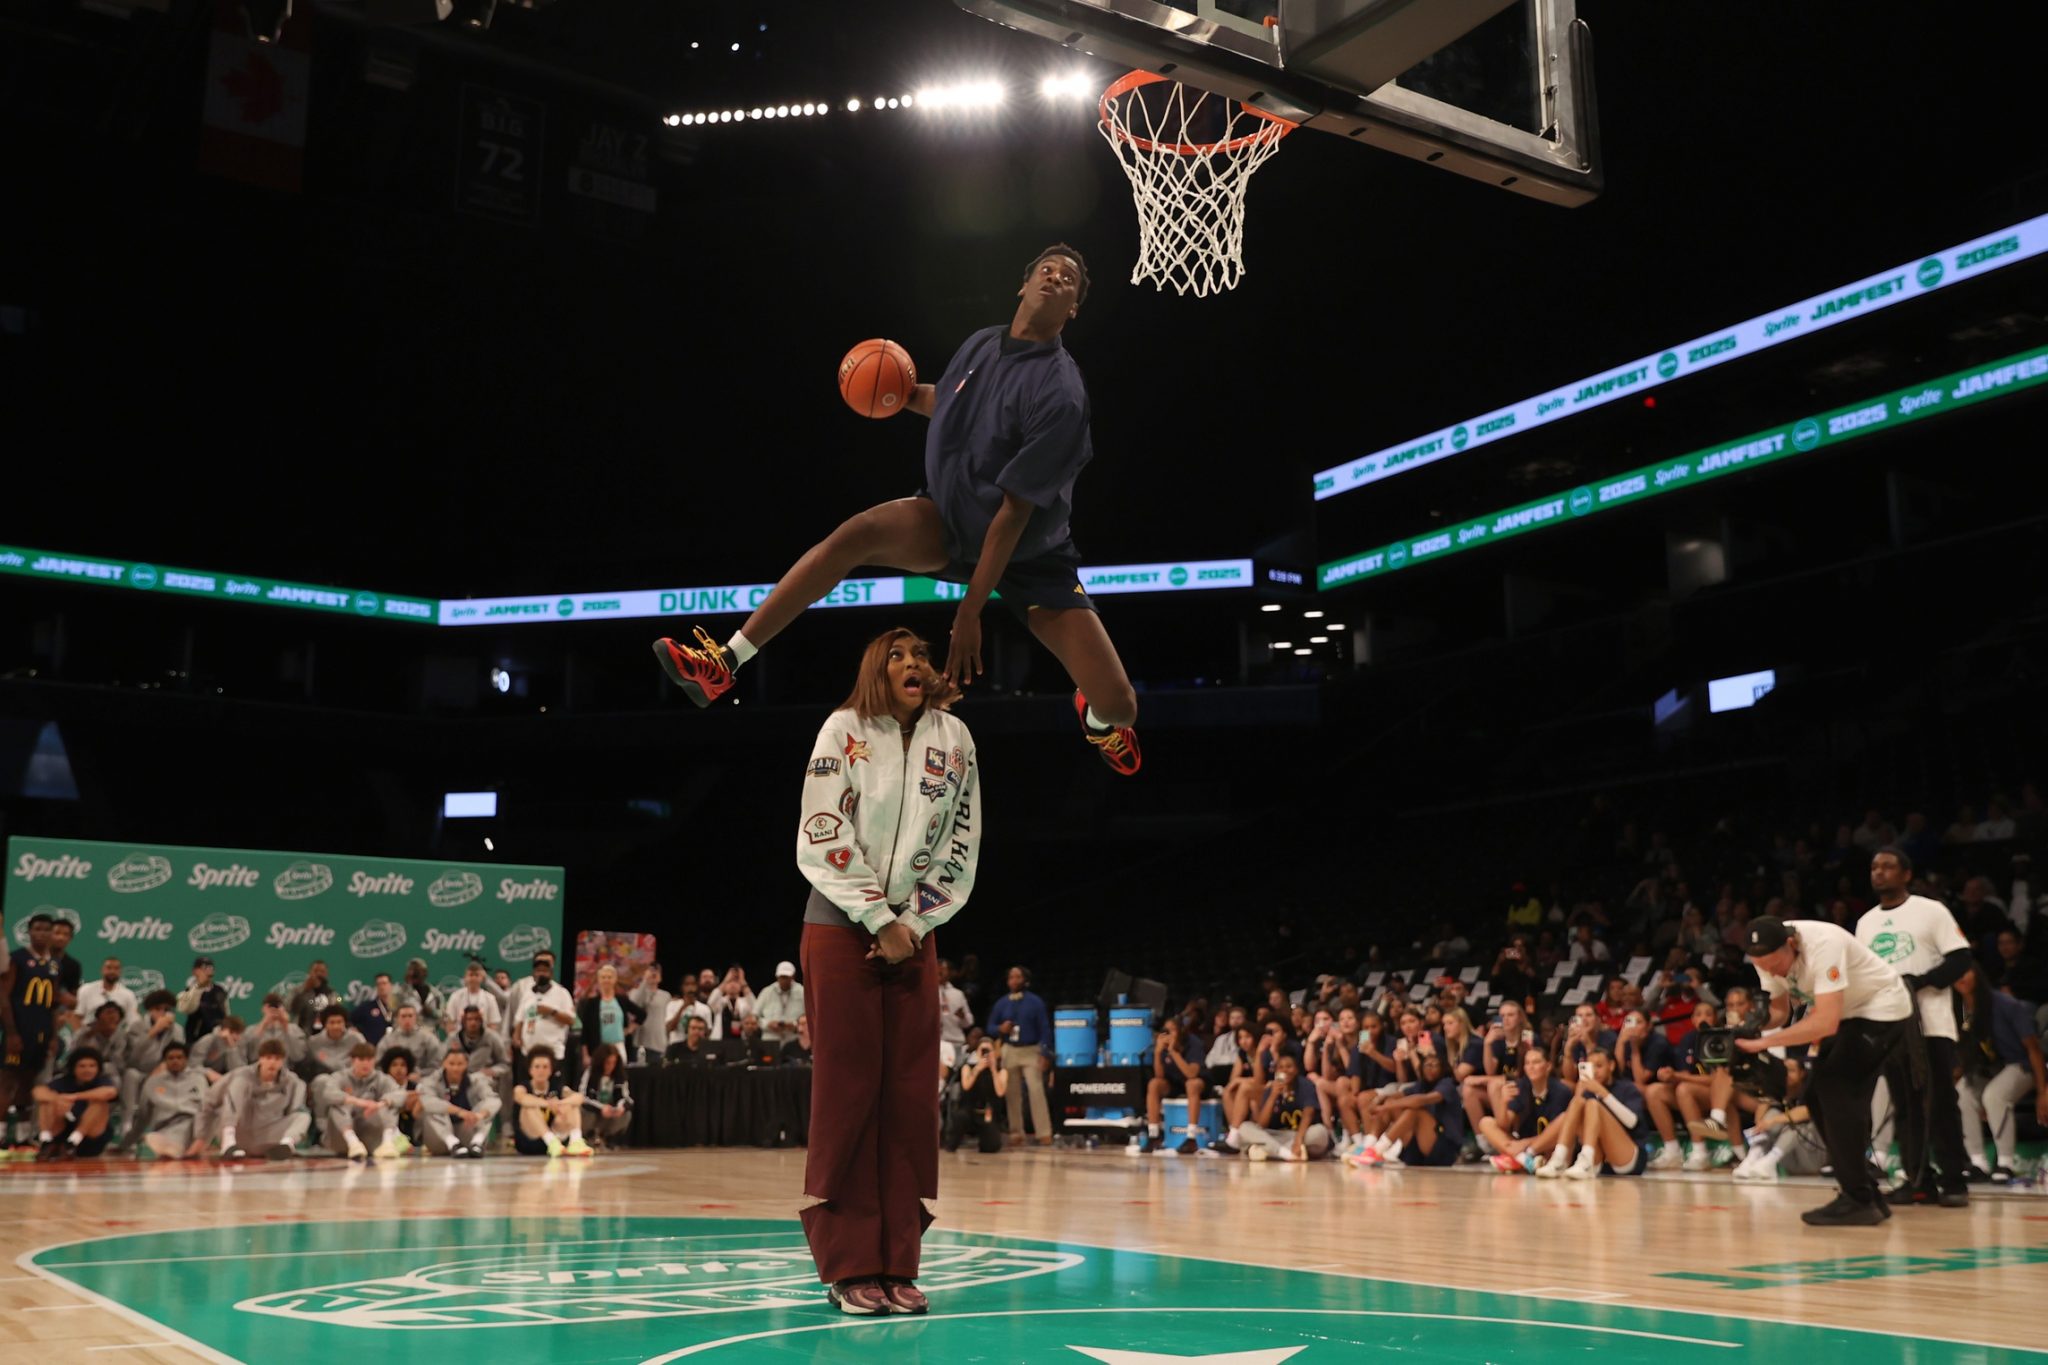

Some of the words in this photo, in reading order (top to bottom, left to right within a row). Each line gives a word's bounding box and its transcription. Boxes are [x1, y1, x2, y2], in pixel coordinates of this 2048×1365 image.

[477, 140, 524, 182] 72
[1383, 438, 1444, 469] JAMFEST
[1476, 413, 1516, 437] 2025
[1535, 396, 1565, 416] Sprite
[1573, 366, 1648, 404] JAMFEST
[1688, 335, 1737, 363] 2025
[1763, 314, 1801, 337] Sprite
[1810, 275, 1905, 320] JAMFEST
[1956, 235, 2020, 270] 2025
[1323, 553, 1384, 584] JAMFEST
[1412, 533, 1451, 557] 2025
[1457, 524, 1487, 543] Sprite
[1492, 499, 1564, 533] JAMFEST
[1599, 474, 1647, 502] 2025
[1654, 464, 1689, 486] Sprite
[1697, 434, 1786, 473] JAMFEST
[1828, 403, 1888, 435] 2025
[1898, 389, 1943, 415] Sprite
[1951, 354, 2048, 399] JAMFES
[32, 556, 125, 580] JAMFEST
[163, 572, 215, 591] 2025
[224, 579, 261, 596] Sprite
[266, 585, 349, 607] JAMFEST
[384, 599, 431, 617] 2025
[1087, 572, 1160, 585] JAMFEST
[1197, 567, 1241, 580] 2025
[484, 603, 550, 616] JAMFEST
[582, 600, 621, 612] 2025
[659, 590, 738, 612] DUNK
[749, 582, 876, 608] CEST
[813, 829, 833, 838] KANI
[14, 852, 92, 882] Sprite
[187, 862, 260, 890] Sprite
[347, 871, 415, 898] Sprite
[496, 878, 559, 904] Sprite
[920, 889, 941, 906] KANI
[97, 915, 173, 943] Sprite
[265, 921, 336, 949] Sprite
[421, 928, 486, 954] Sprite
[1070, 1082, 1126, 1095] POWERADE
[481, 1261, 797, 1285] Sprite
